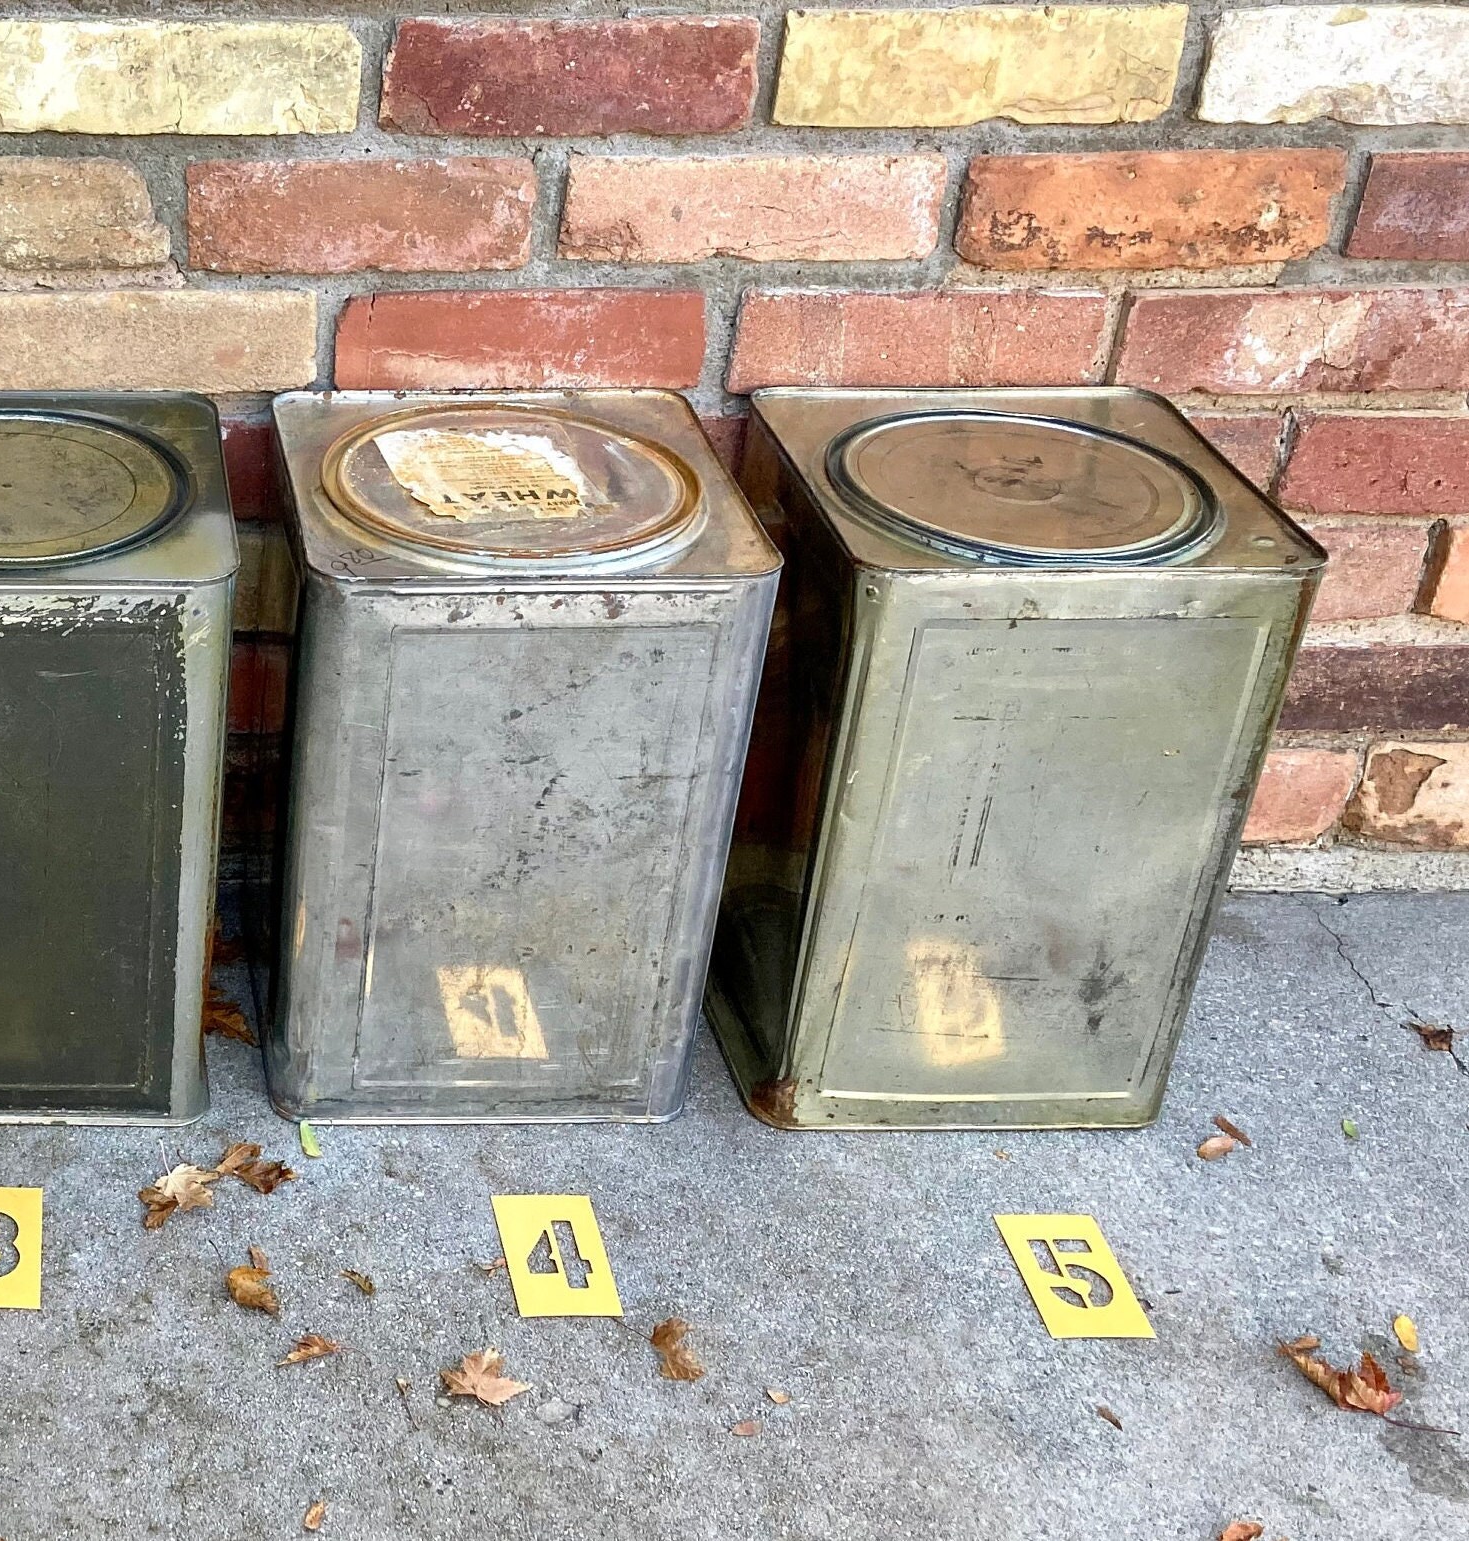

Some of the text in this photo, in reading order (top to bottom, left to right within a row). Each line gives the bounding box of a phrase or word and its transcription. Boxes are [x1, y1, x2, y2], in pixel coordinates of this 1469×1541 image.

[442, 488, 578, 504] WHEAT
[527, 1220, 594, 1289] 4
[1026, 1239, 1114, 1309] 5
